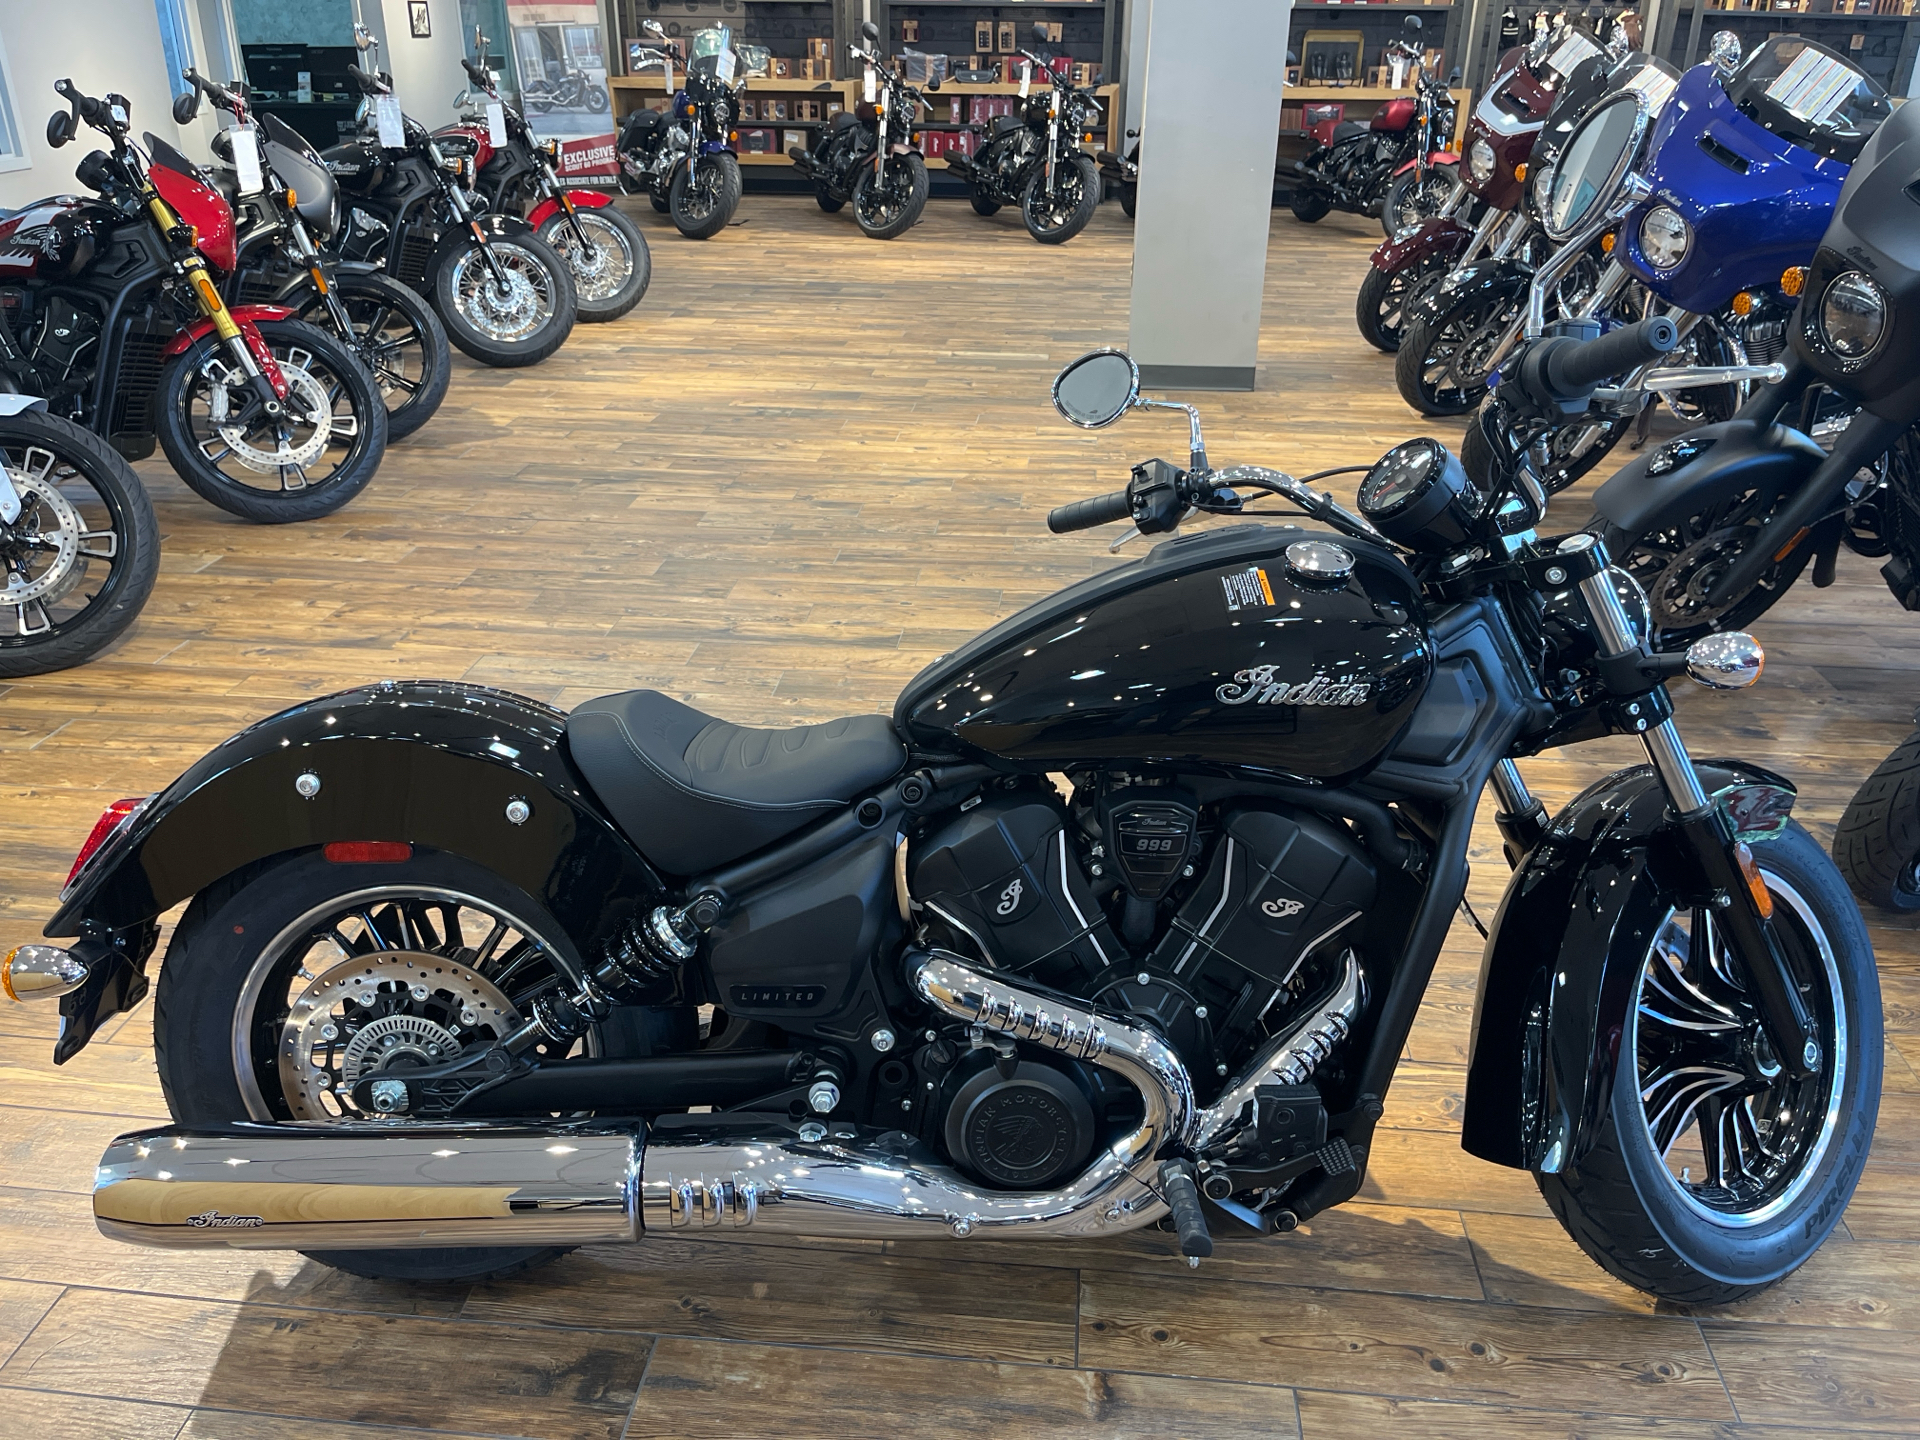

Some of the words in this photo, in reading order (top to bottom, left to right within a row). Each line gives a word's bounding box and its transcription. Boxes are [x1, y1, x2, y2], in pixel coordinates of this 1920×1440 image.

[563, 145, 616, 166] EXCLUSIVE
[565, 162, 583, 172] SCOUT
[10, 234, 41, 246] Indian
[1215, 664, 1371, 707] Indian
[1142, 818, 1167, 826] Indian
[1136, 839, 1172, 851] 999
[741, 992, 814, 1001] LIMITED
[1804, 1111, 1868, 1240] PIRELLI
[193, 1209, 257, 1228] Indian
